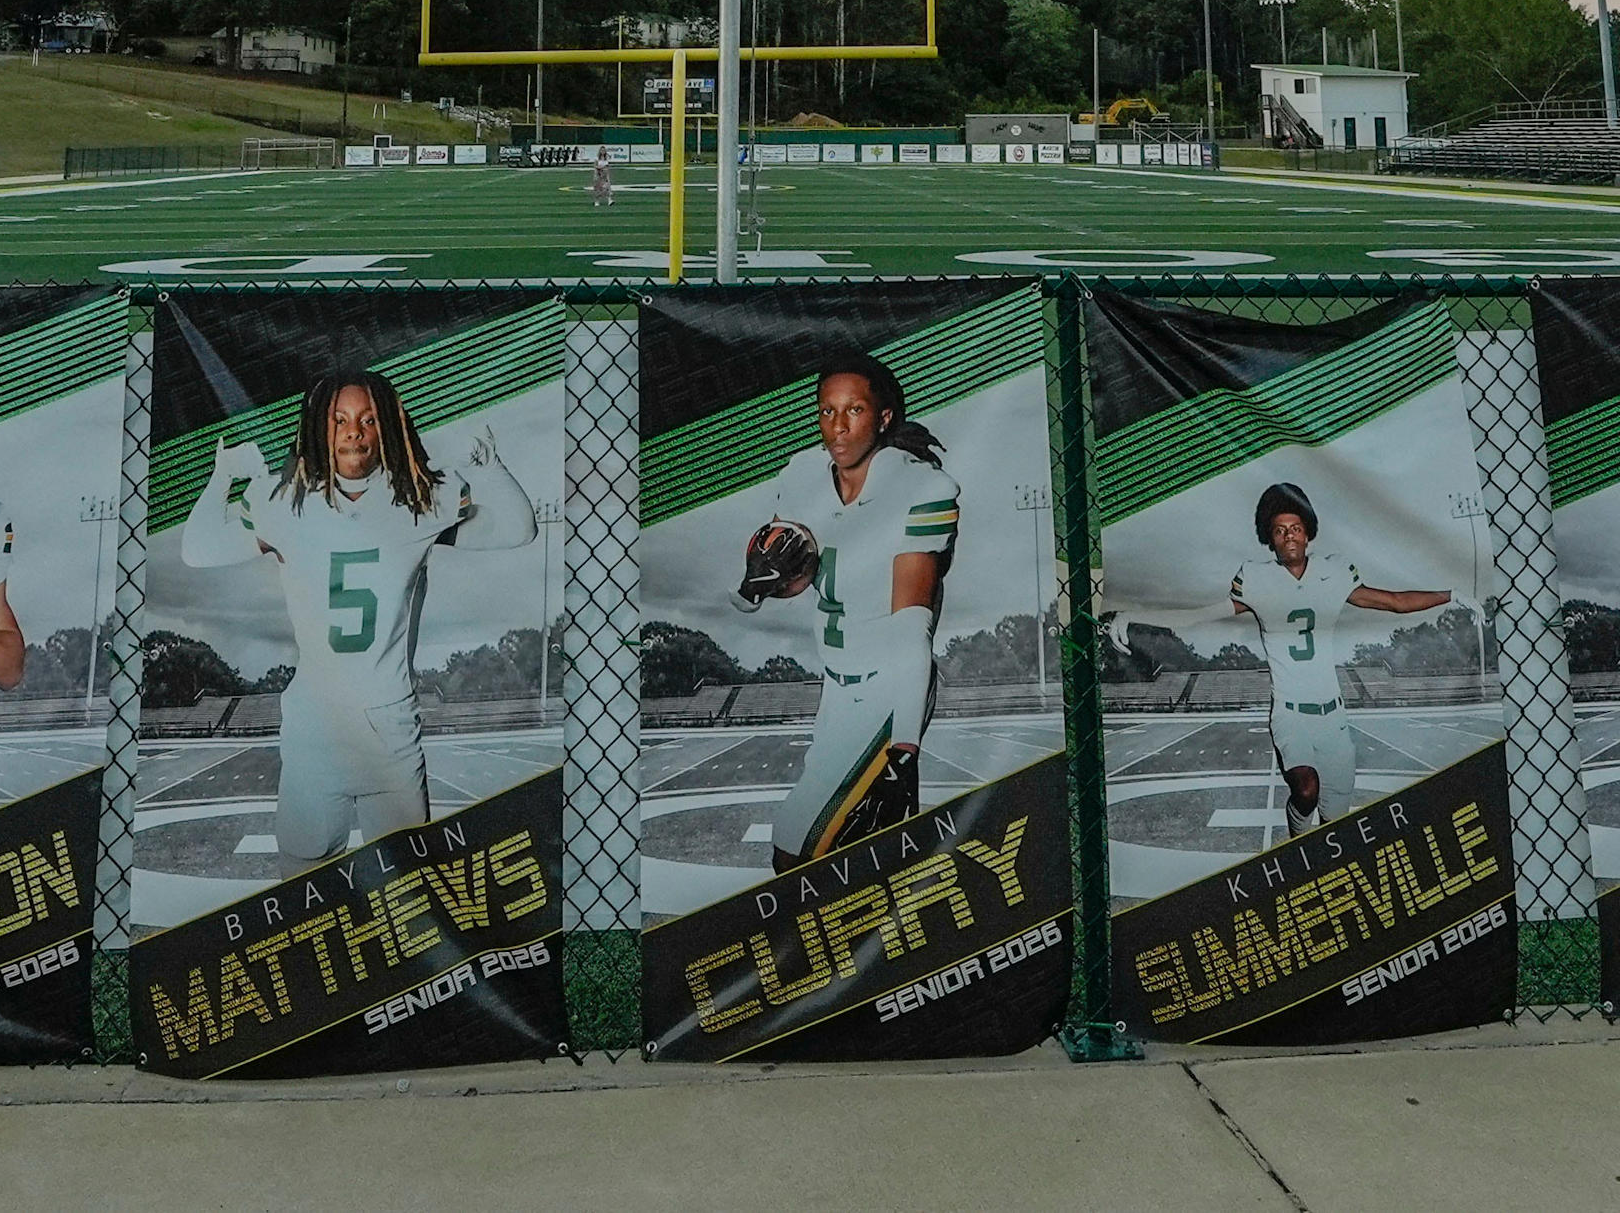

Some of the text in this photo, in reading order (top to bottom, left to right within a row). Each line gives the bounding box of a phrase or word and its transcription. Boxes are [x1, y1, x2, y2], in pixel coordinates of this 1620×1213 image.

[328, 548, 381, 654] 5
[1285, 606, 1317, 663] 3
[224, 820, 467, 942] BRAYLUN
[755, 810, 958, 920] DAVIAN
[1226, 801, 1409, 903] KHISER
[0, 939, 80, 988] 2026
[149, 829, 548, 1061] MATTHEWS
[684, 813, 1029, 1034] CURRY
[1134, 801, 1500, 1025] SUMMERVILLE
[1341, 902, 1508, 1007] SENIOR 2026
[363, 941, 551, 1035] SENIOR 2026
[874, 920, 1063, 1024] SENIOR 2026
